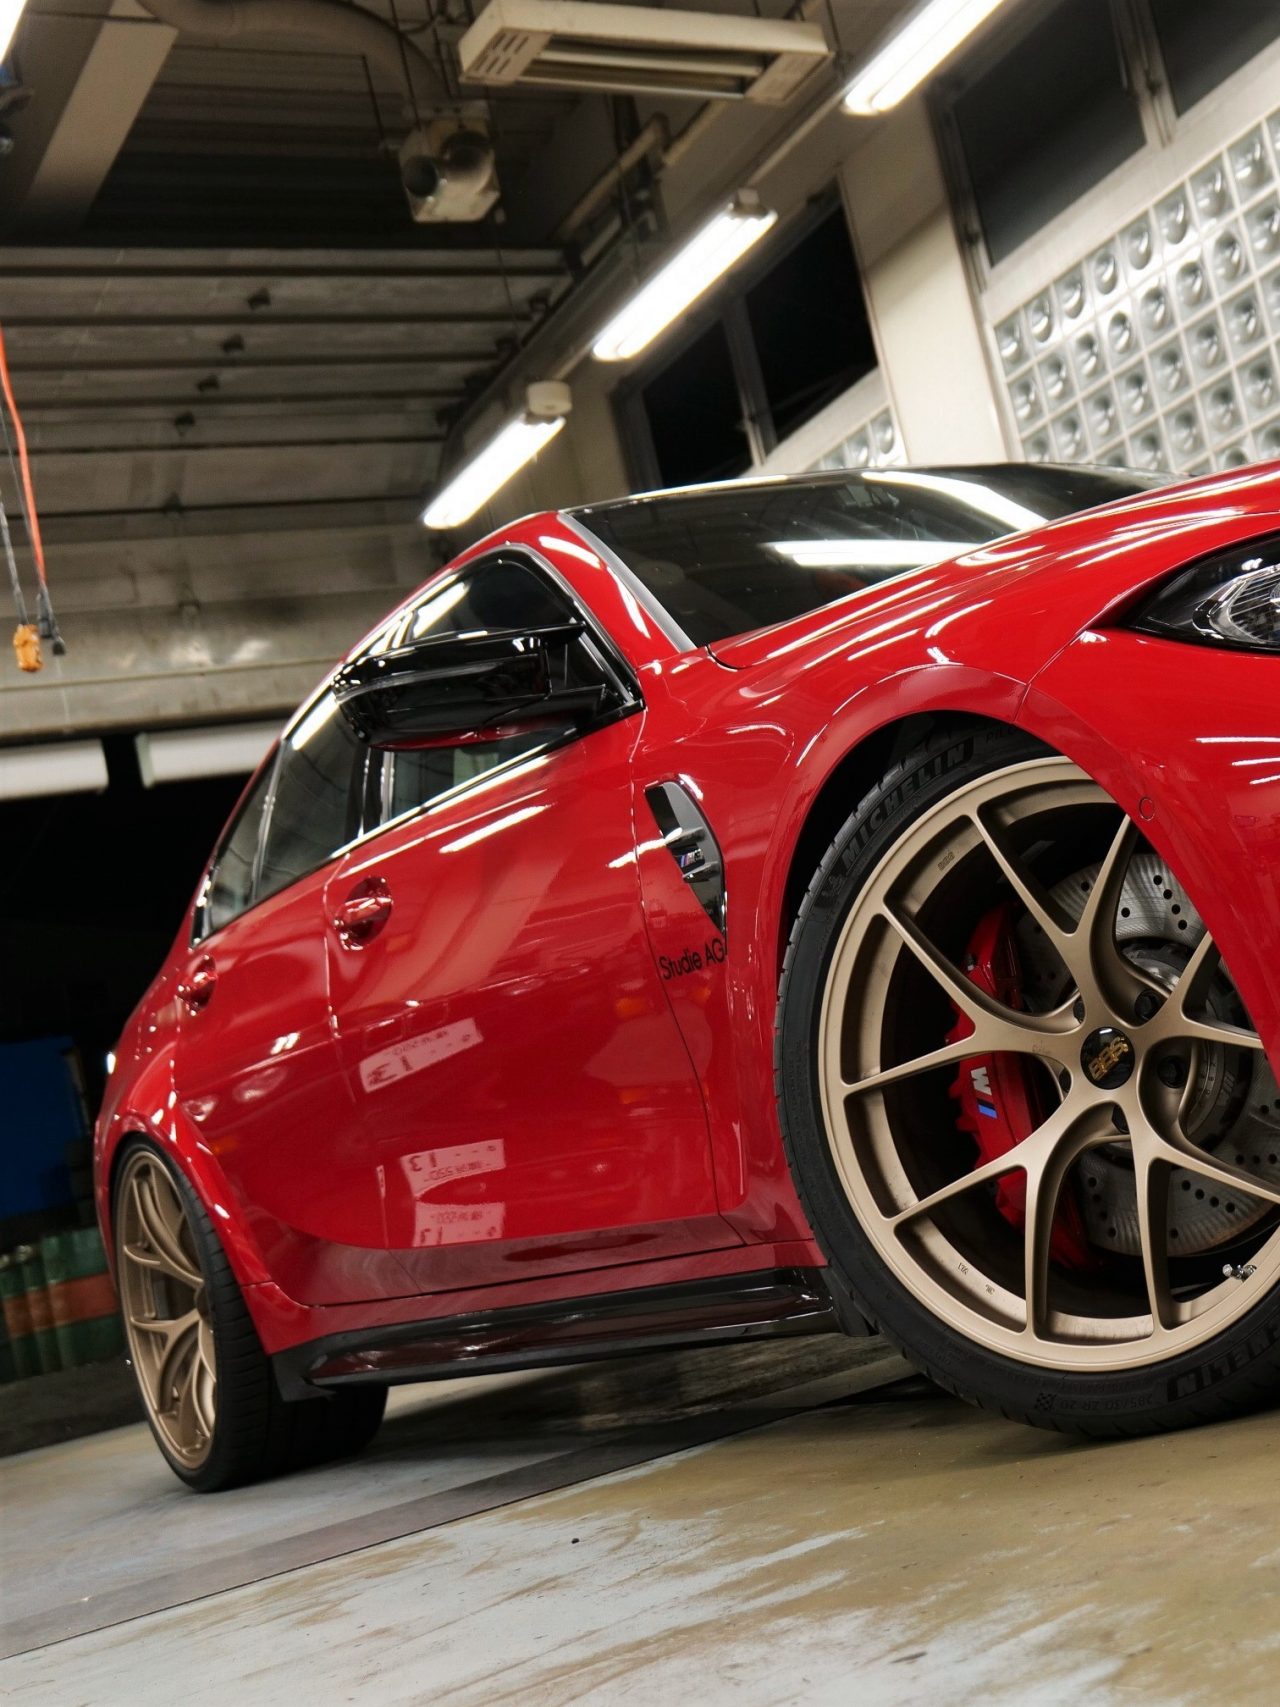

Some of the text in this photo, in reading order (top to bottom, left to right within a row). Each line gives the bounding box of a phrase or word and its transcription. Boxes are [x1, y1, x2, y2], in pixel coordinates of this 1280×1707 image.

[841, 743, 965, 867] MICHELIN
[659, 938, 726, 980] Studie AG
[1088, 1036, 1129, 1080] BBS
